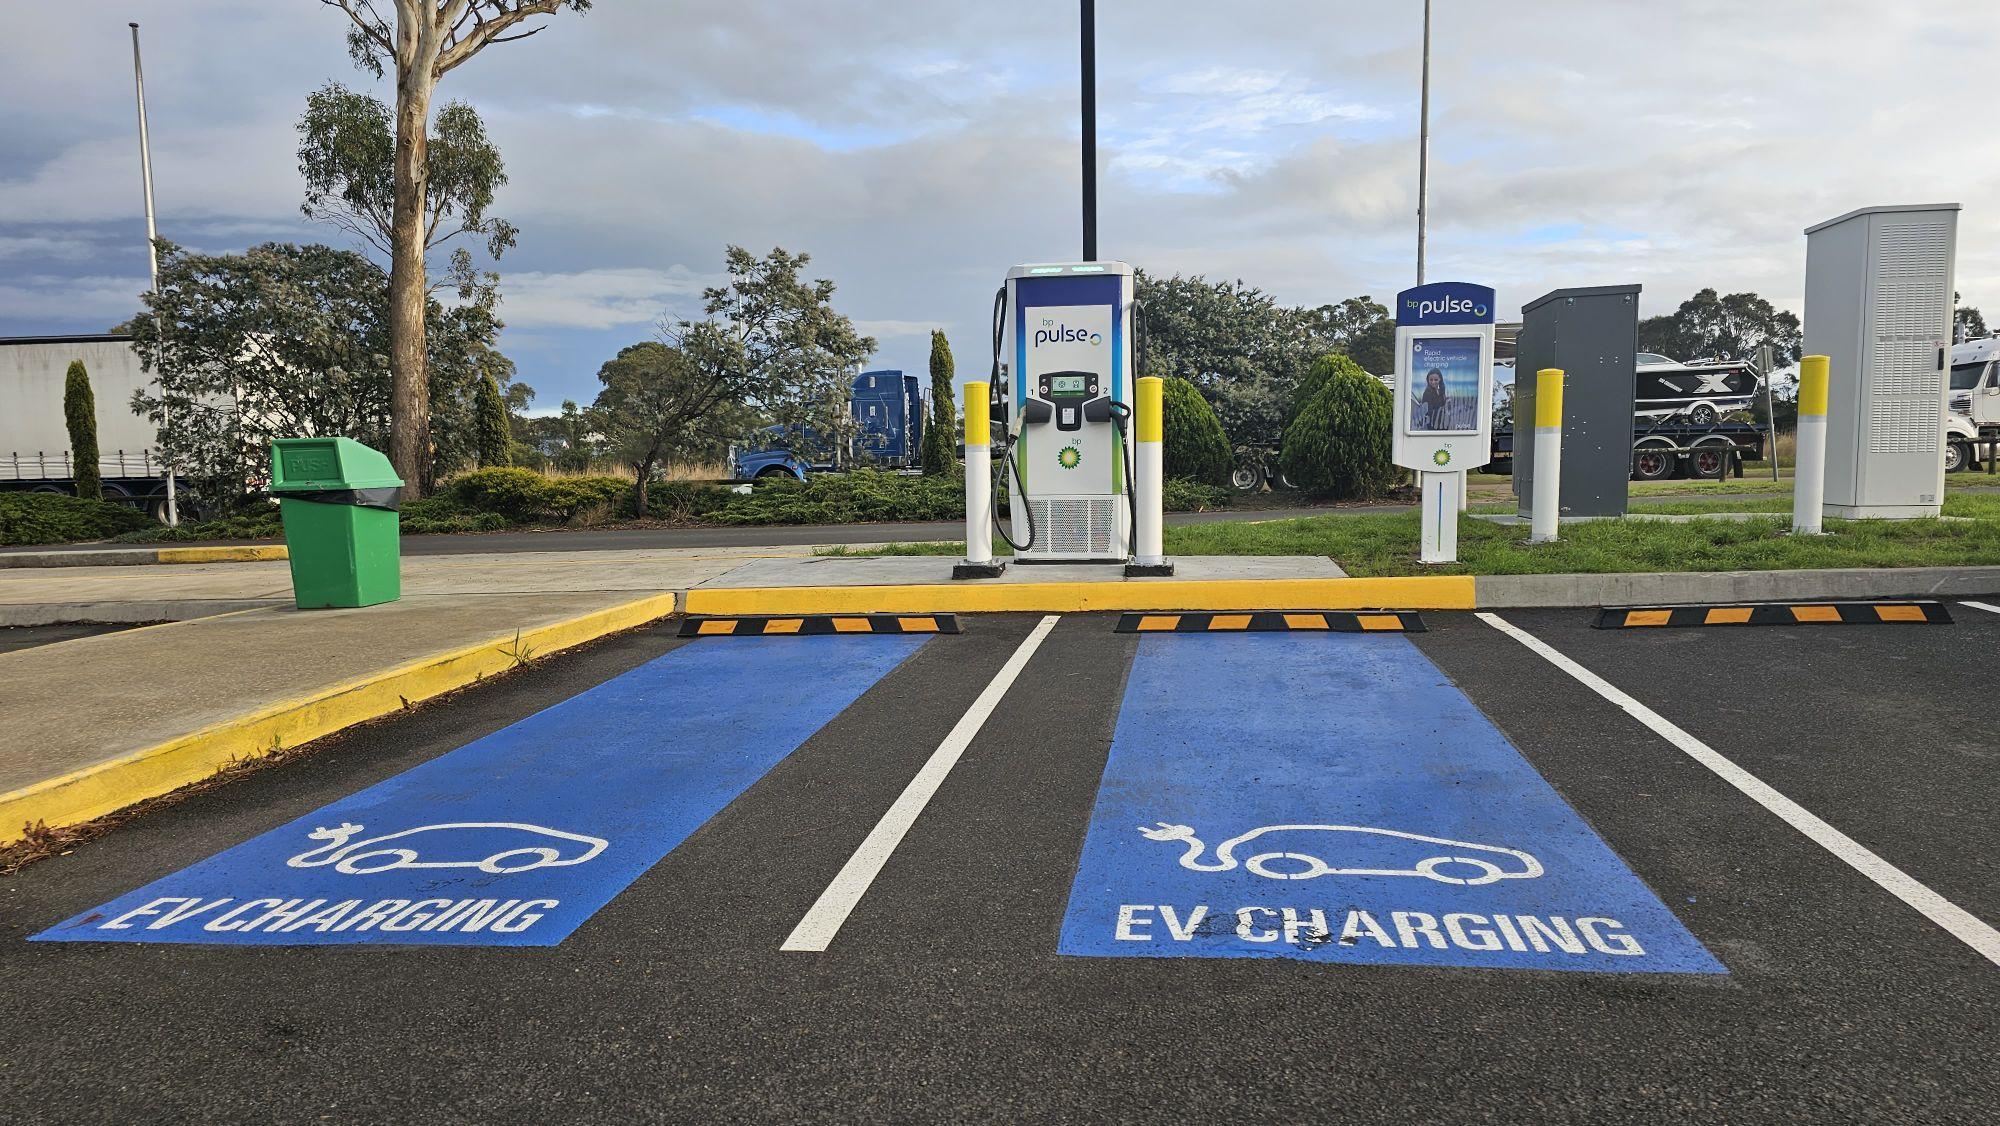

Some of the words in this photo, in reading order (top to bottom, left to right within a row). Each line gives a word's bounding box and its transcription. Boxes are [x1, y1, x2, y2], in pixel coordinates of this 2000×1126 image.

[1407, 299, 1419, 309] bp
[1419, 294, 1473, 319] pulse
[1042, 318, 1054, 327] bp
[1035, 323, 1088, 348] pulse
[1424, 349, 1441, 357] Rapid
[1072, 437, 1082, 446] bp
[98, 898, 234, 930] EV
[203, 898, 560, 933] CHARGING
[1115, 904, 1209, 941] EV
[1236, 906, 1647, 956] CHARGING
